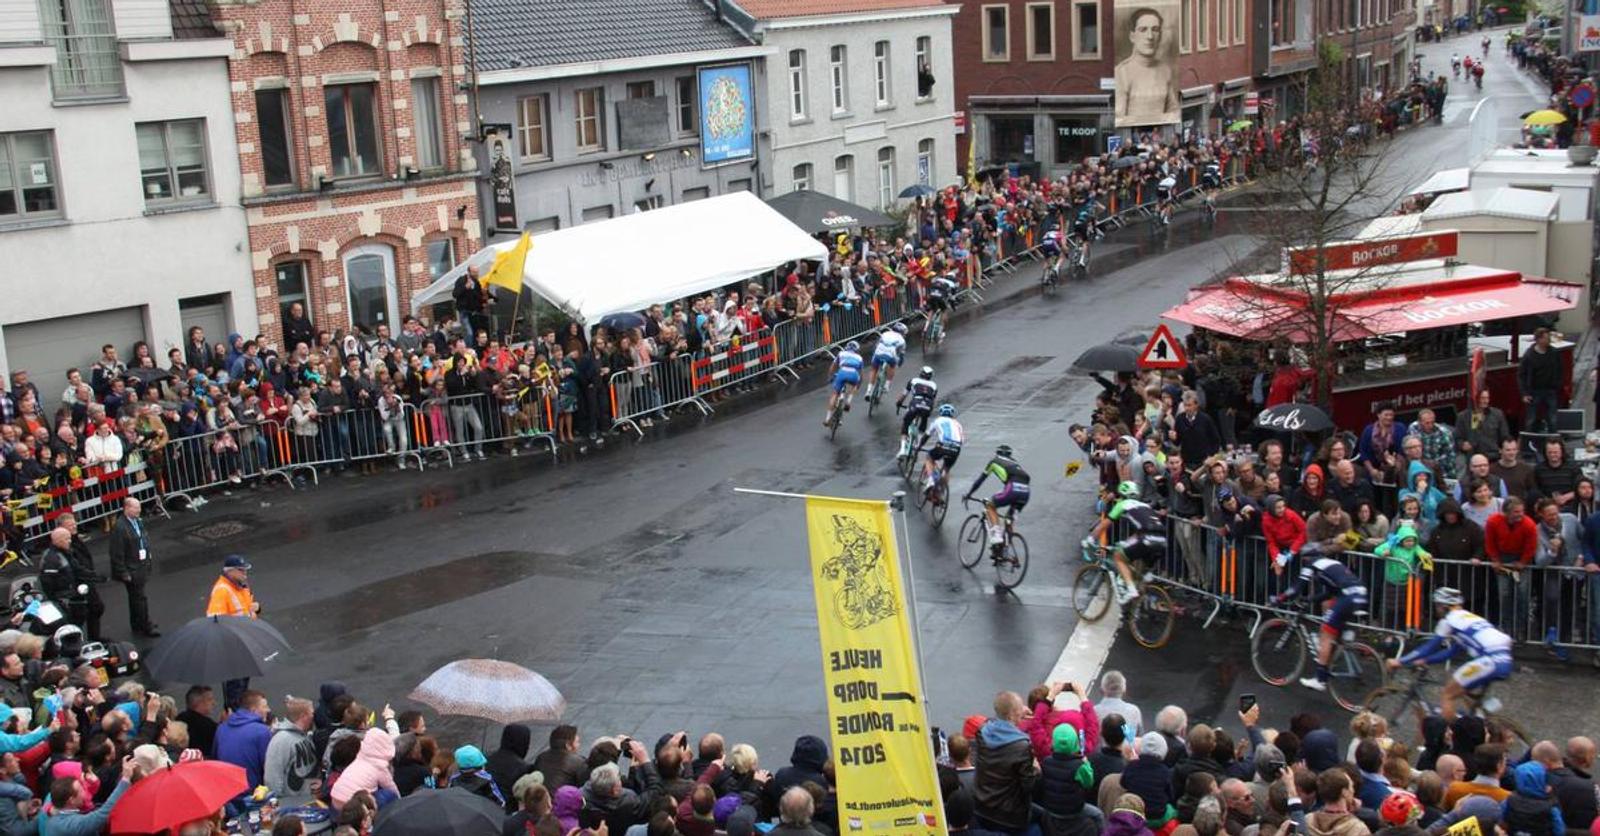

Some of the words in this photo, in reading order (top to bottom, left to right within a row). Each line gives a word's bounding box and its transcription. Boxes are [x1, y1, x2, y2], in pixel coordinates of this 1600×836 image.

[1059, 127, 1069, 136] TE
[1072, 127, 1097, 136] KOOP
[1406, 394, 1424, 405] het
[1427, 387, 1466, 406] plezier
